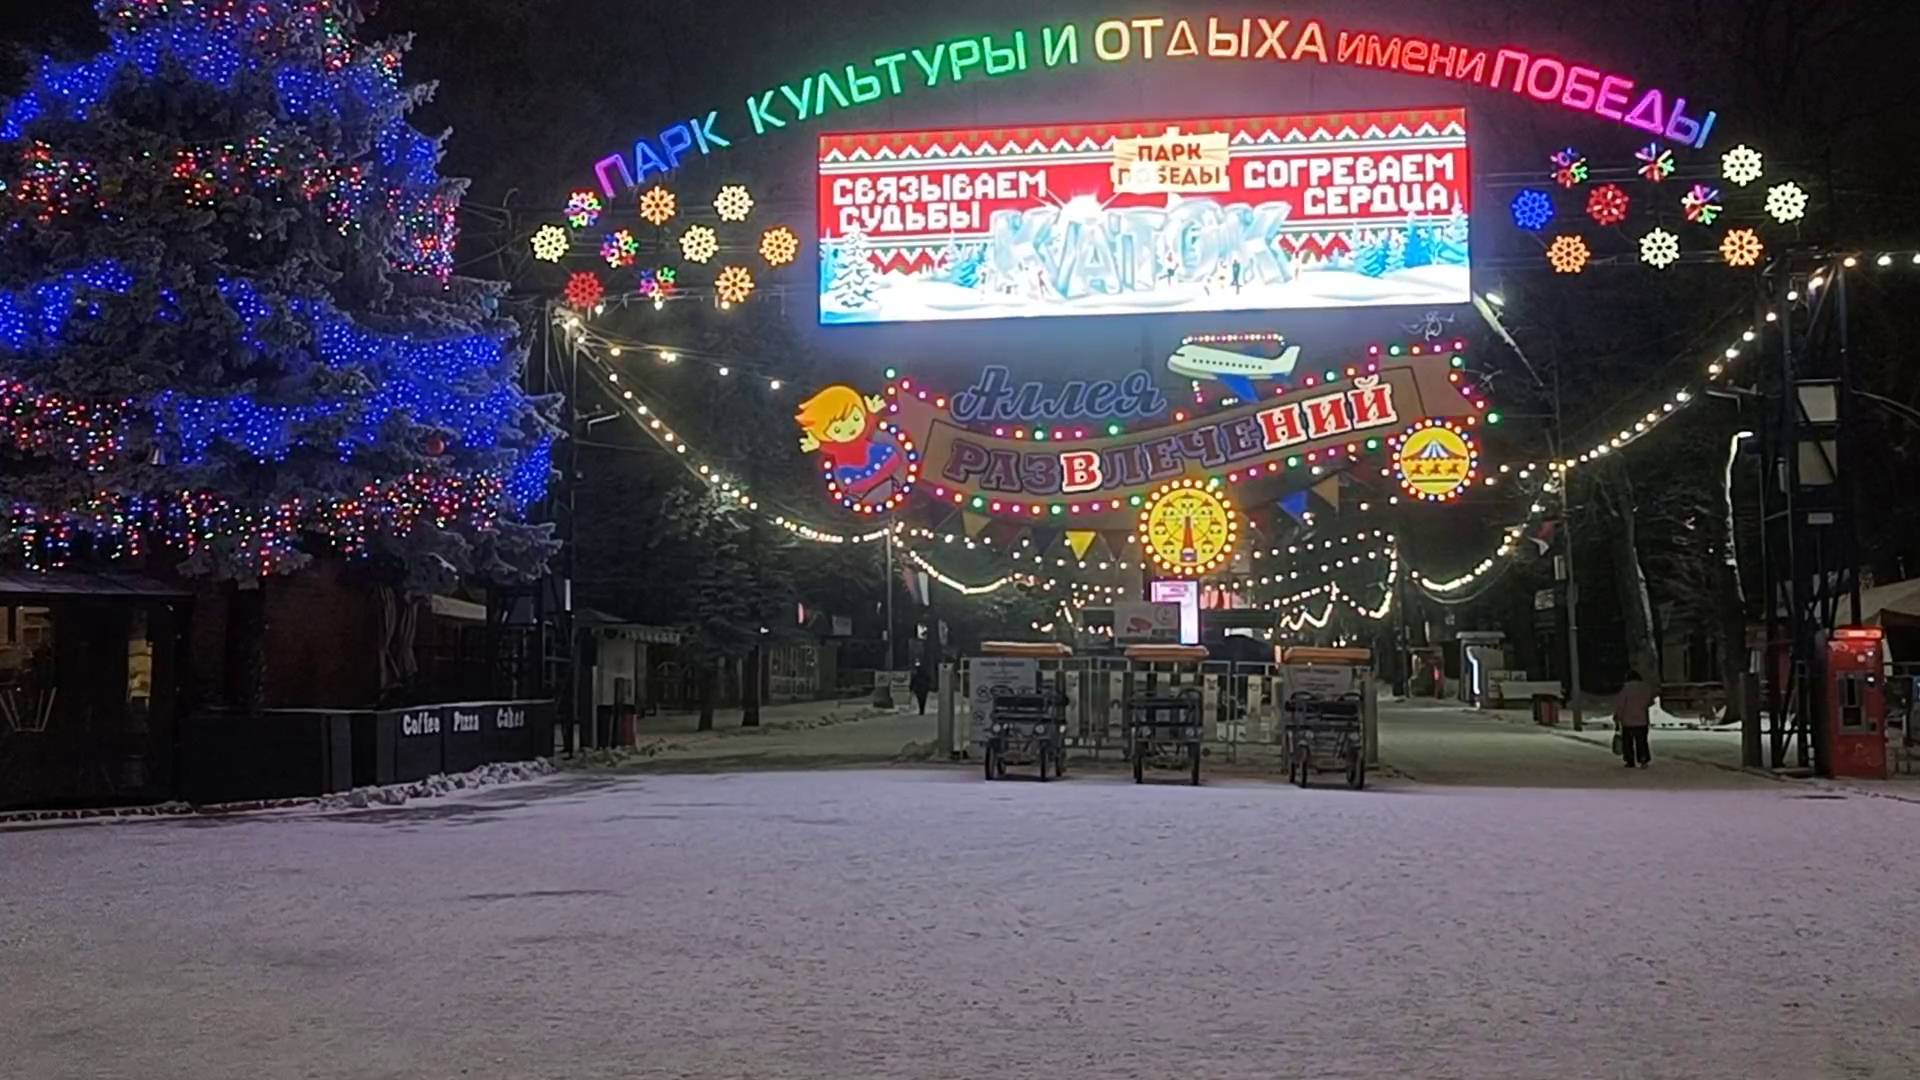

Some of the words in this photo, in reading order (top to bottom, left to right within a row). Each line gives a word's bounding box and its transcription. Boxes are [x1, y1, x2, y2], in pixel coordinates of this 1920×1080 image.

[594, 110, 731, 198] ПАРК
[746, 31, 1027, 135] КУЛЬТУРЫ
[1042, 24, 1079, 67] И
[1094, 16, 1329, 63] ОТДЫХА
[1490, 48, 1717, 150] ПОБЕДЫ
[1137, 142, 1203, 162] ПАРК
[832, 170, 1048, 206] СВЯЗЫВАЕМ
[1243, 152, 1455, 190] СОГРЕВАЕМ
[1303, 181, 1450, 216] СЕРДЦА
[838, 201, 981, 234] СУДЬБЫ
[950, 364, 1166, 422] Аллея
[942, 374, 1399, 493] РАЗВЛЕЧЕНИЙ
[403, 711, 441, 735] Coffee
[453, 711, 480, 732] Pizza
